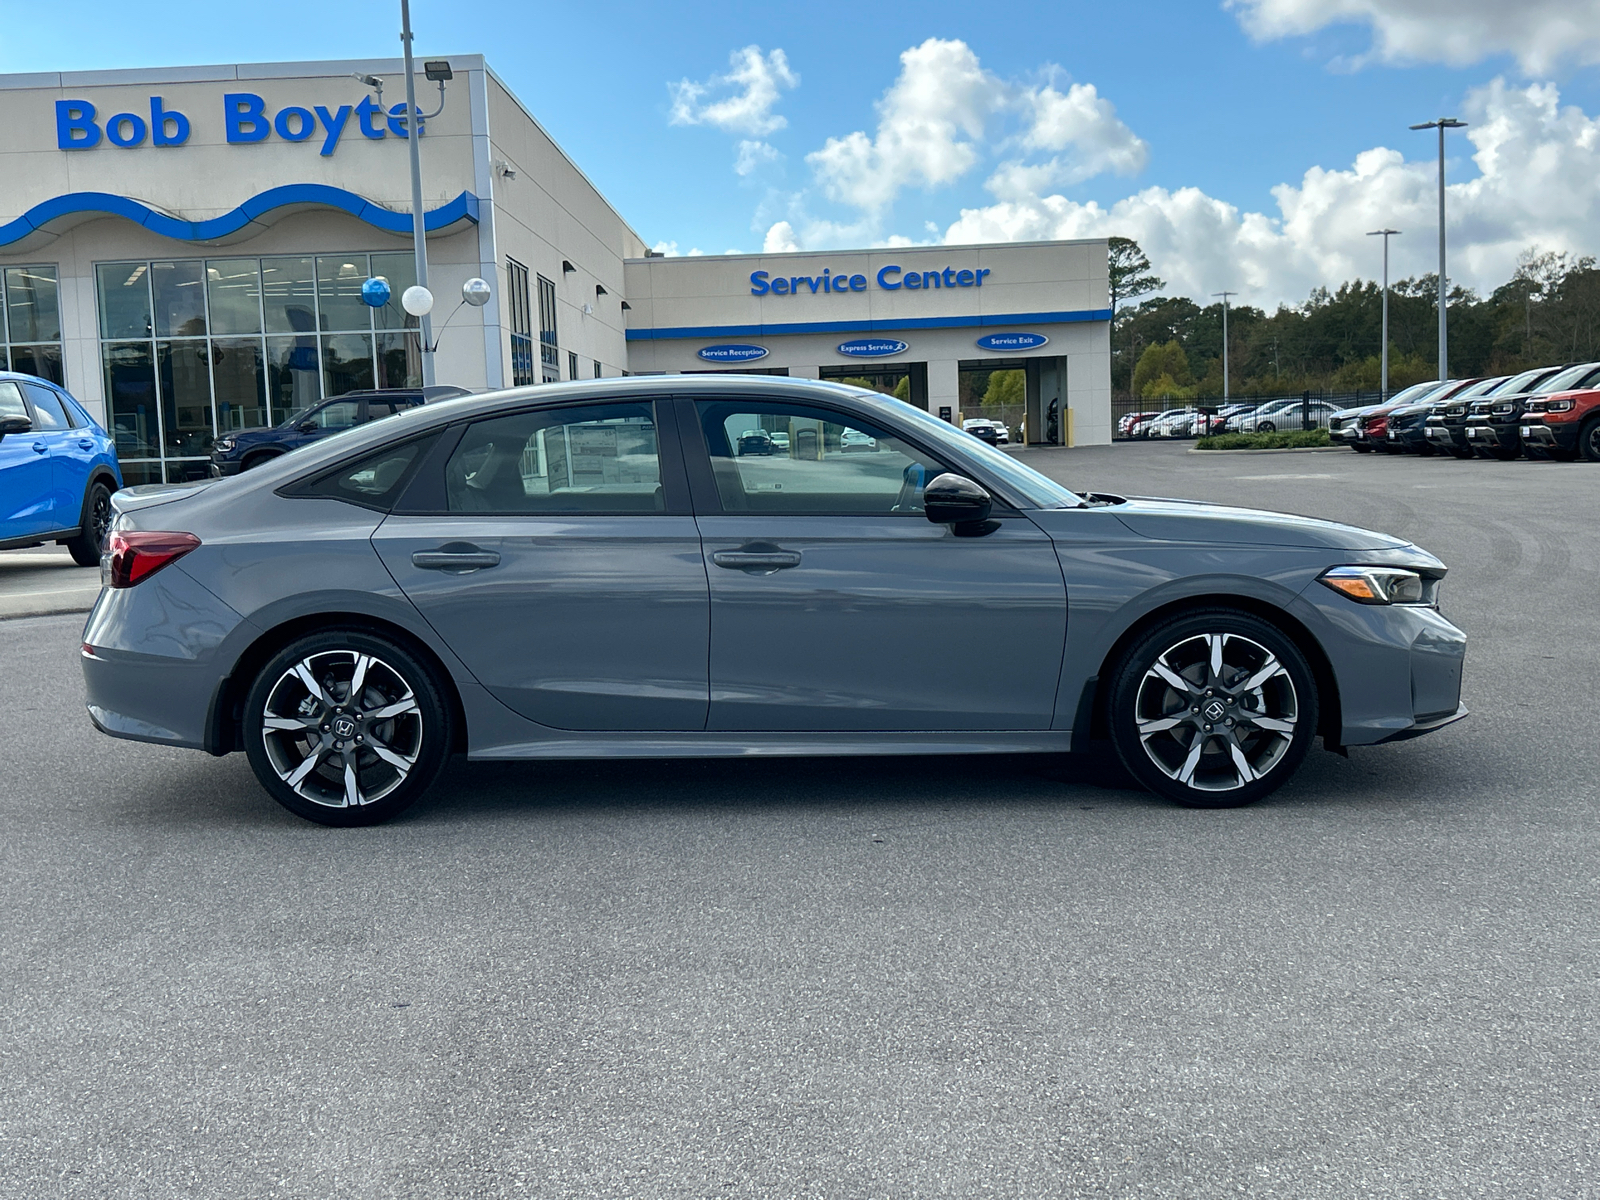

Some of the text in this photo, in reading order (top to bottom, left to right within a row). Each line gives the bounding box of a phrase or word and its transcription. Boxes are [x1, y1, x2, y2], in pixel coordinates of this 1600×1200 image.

[55, 92, 426, 157] Bob Boyte
[749, 264, 991, 297] Service Center
[840, 344, 866, 352] Express
